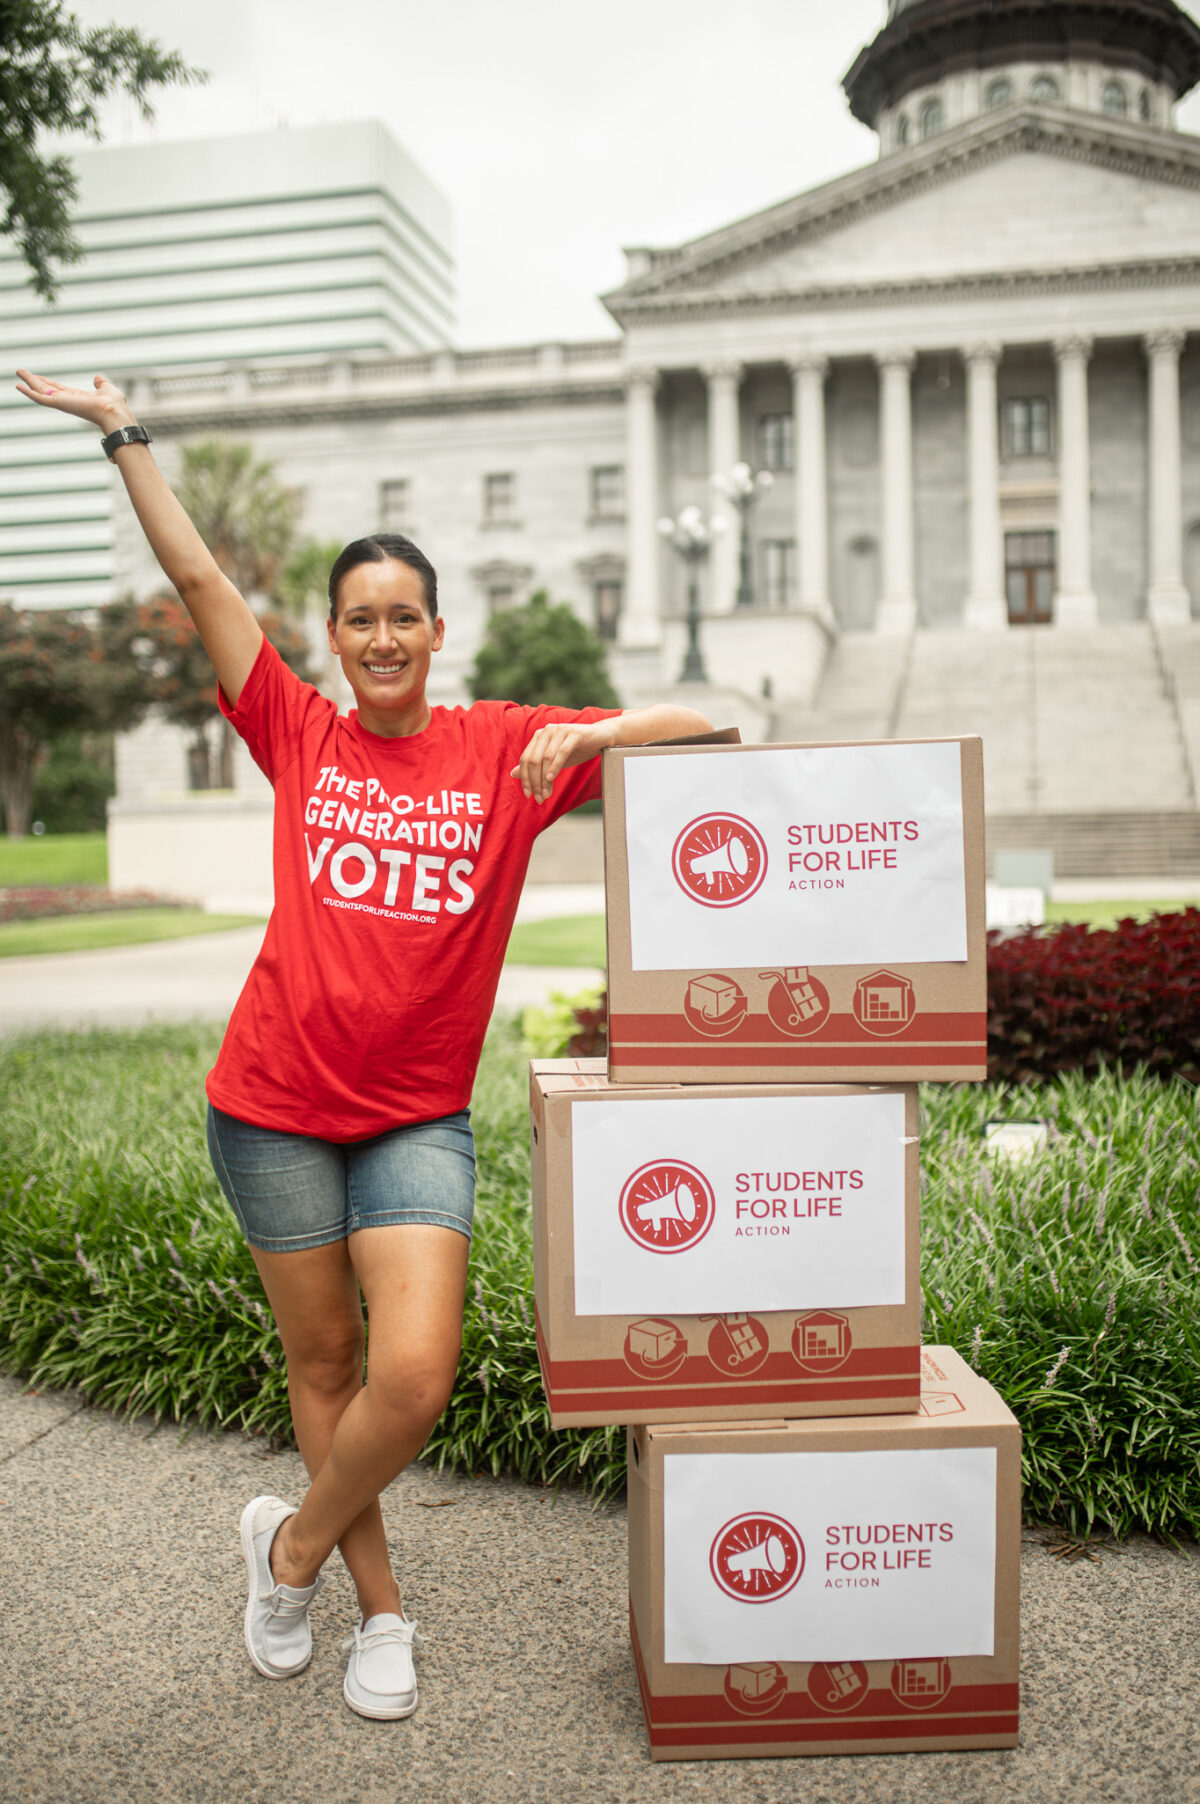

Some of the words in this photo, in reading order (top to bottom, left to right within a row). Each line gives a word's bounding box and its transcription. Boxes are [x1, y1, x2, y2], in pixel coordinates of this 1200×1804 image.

[314, 765, 365, 801] THE
[304, 795, 484, 853] GENERATION
[786, 820, 919, 846] STUDENTS
[788, 850, 841, 873] FOR
[847, 848, 897, 871] LIFE
[303, 832, 475, 915] VOTES
[788, 879, 845, 890] ACTION
[322, 897, 437, 924] STUDENTSFORLIFEACTION.ORG
[735, 1169, 864, 1193] STUDENTS
[735, 1198, 787, 1220] FOR
[793, 1197, 842, 1218] LIFE
[735, 1225, 791, 1237] ACTION
[825, 1522, 954, 1546] STUDENTS
[825, 1551, 877, 1572] FOR
[883, 1548, 931, 1570] LIFE
[824, 1577, 880, 1589] ACTION
